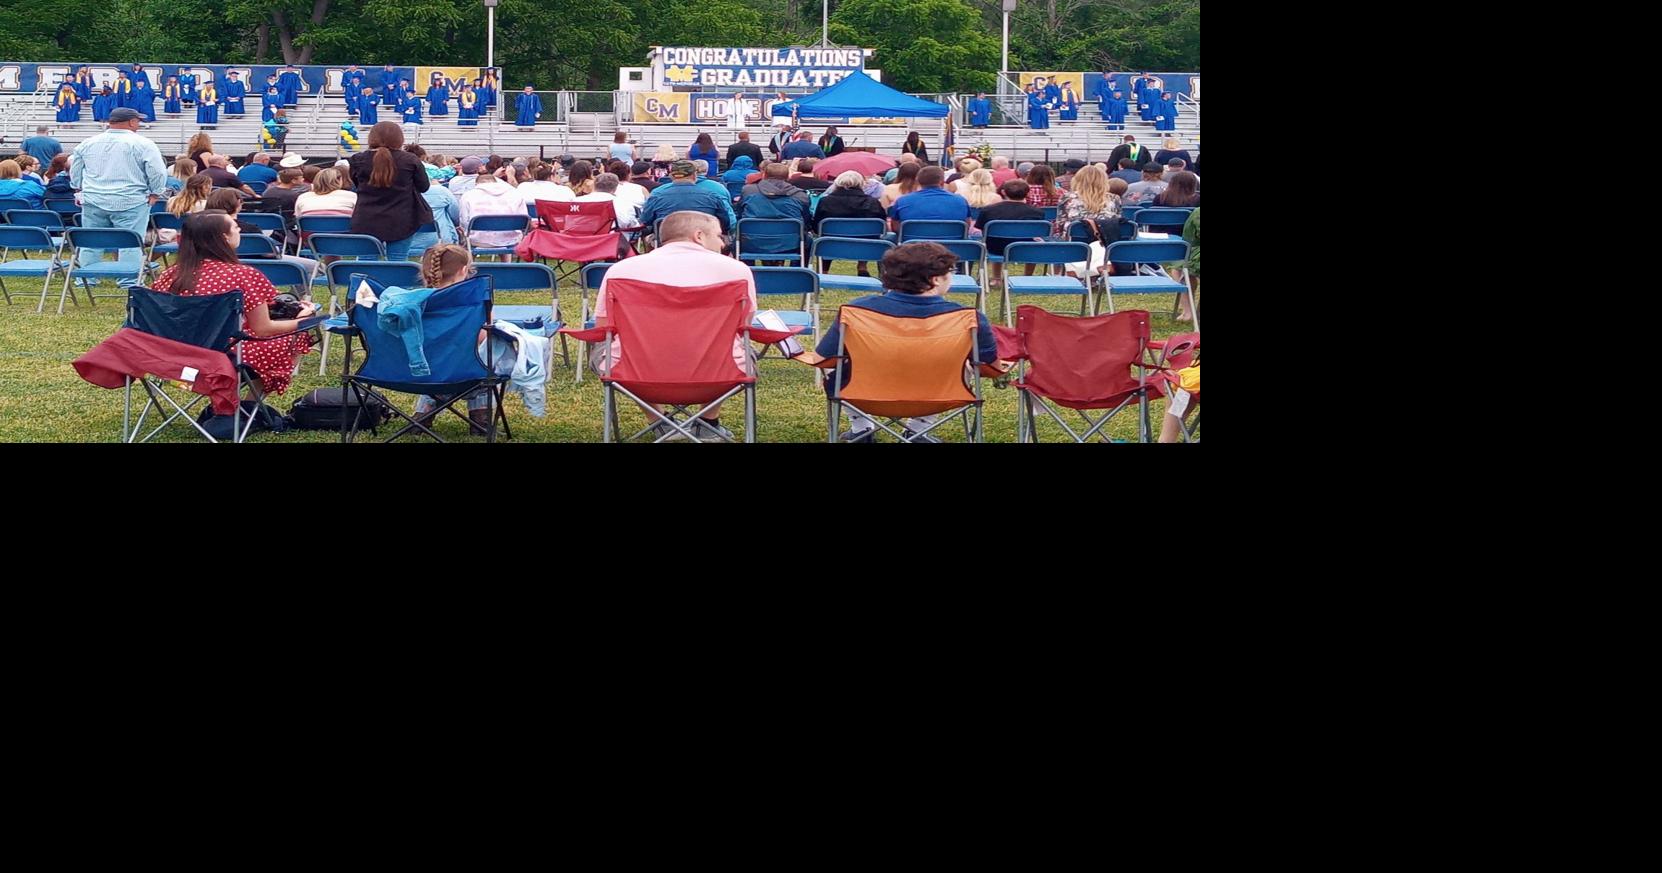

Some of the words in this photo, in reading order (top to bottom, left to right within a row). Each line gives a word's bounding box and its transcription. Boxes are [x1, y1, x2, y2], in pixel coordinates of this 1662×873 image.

[662, 47, 861, 67] CONGRATULATIONS
[645, 97, 679, 119] CM
[697, 99, 761, 119] HOE
